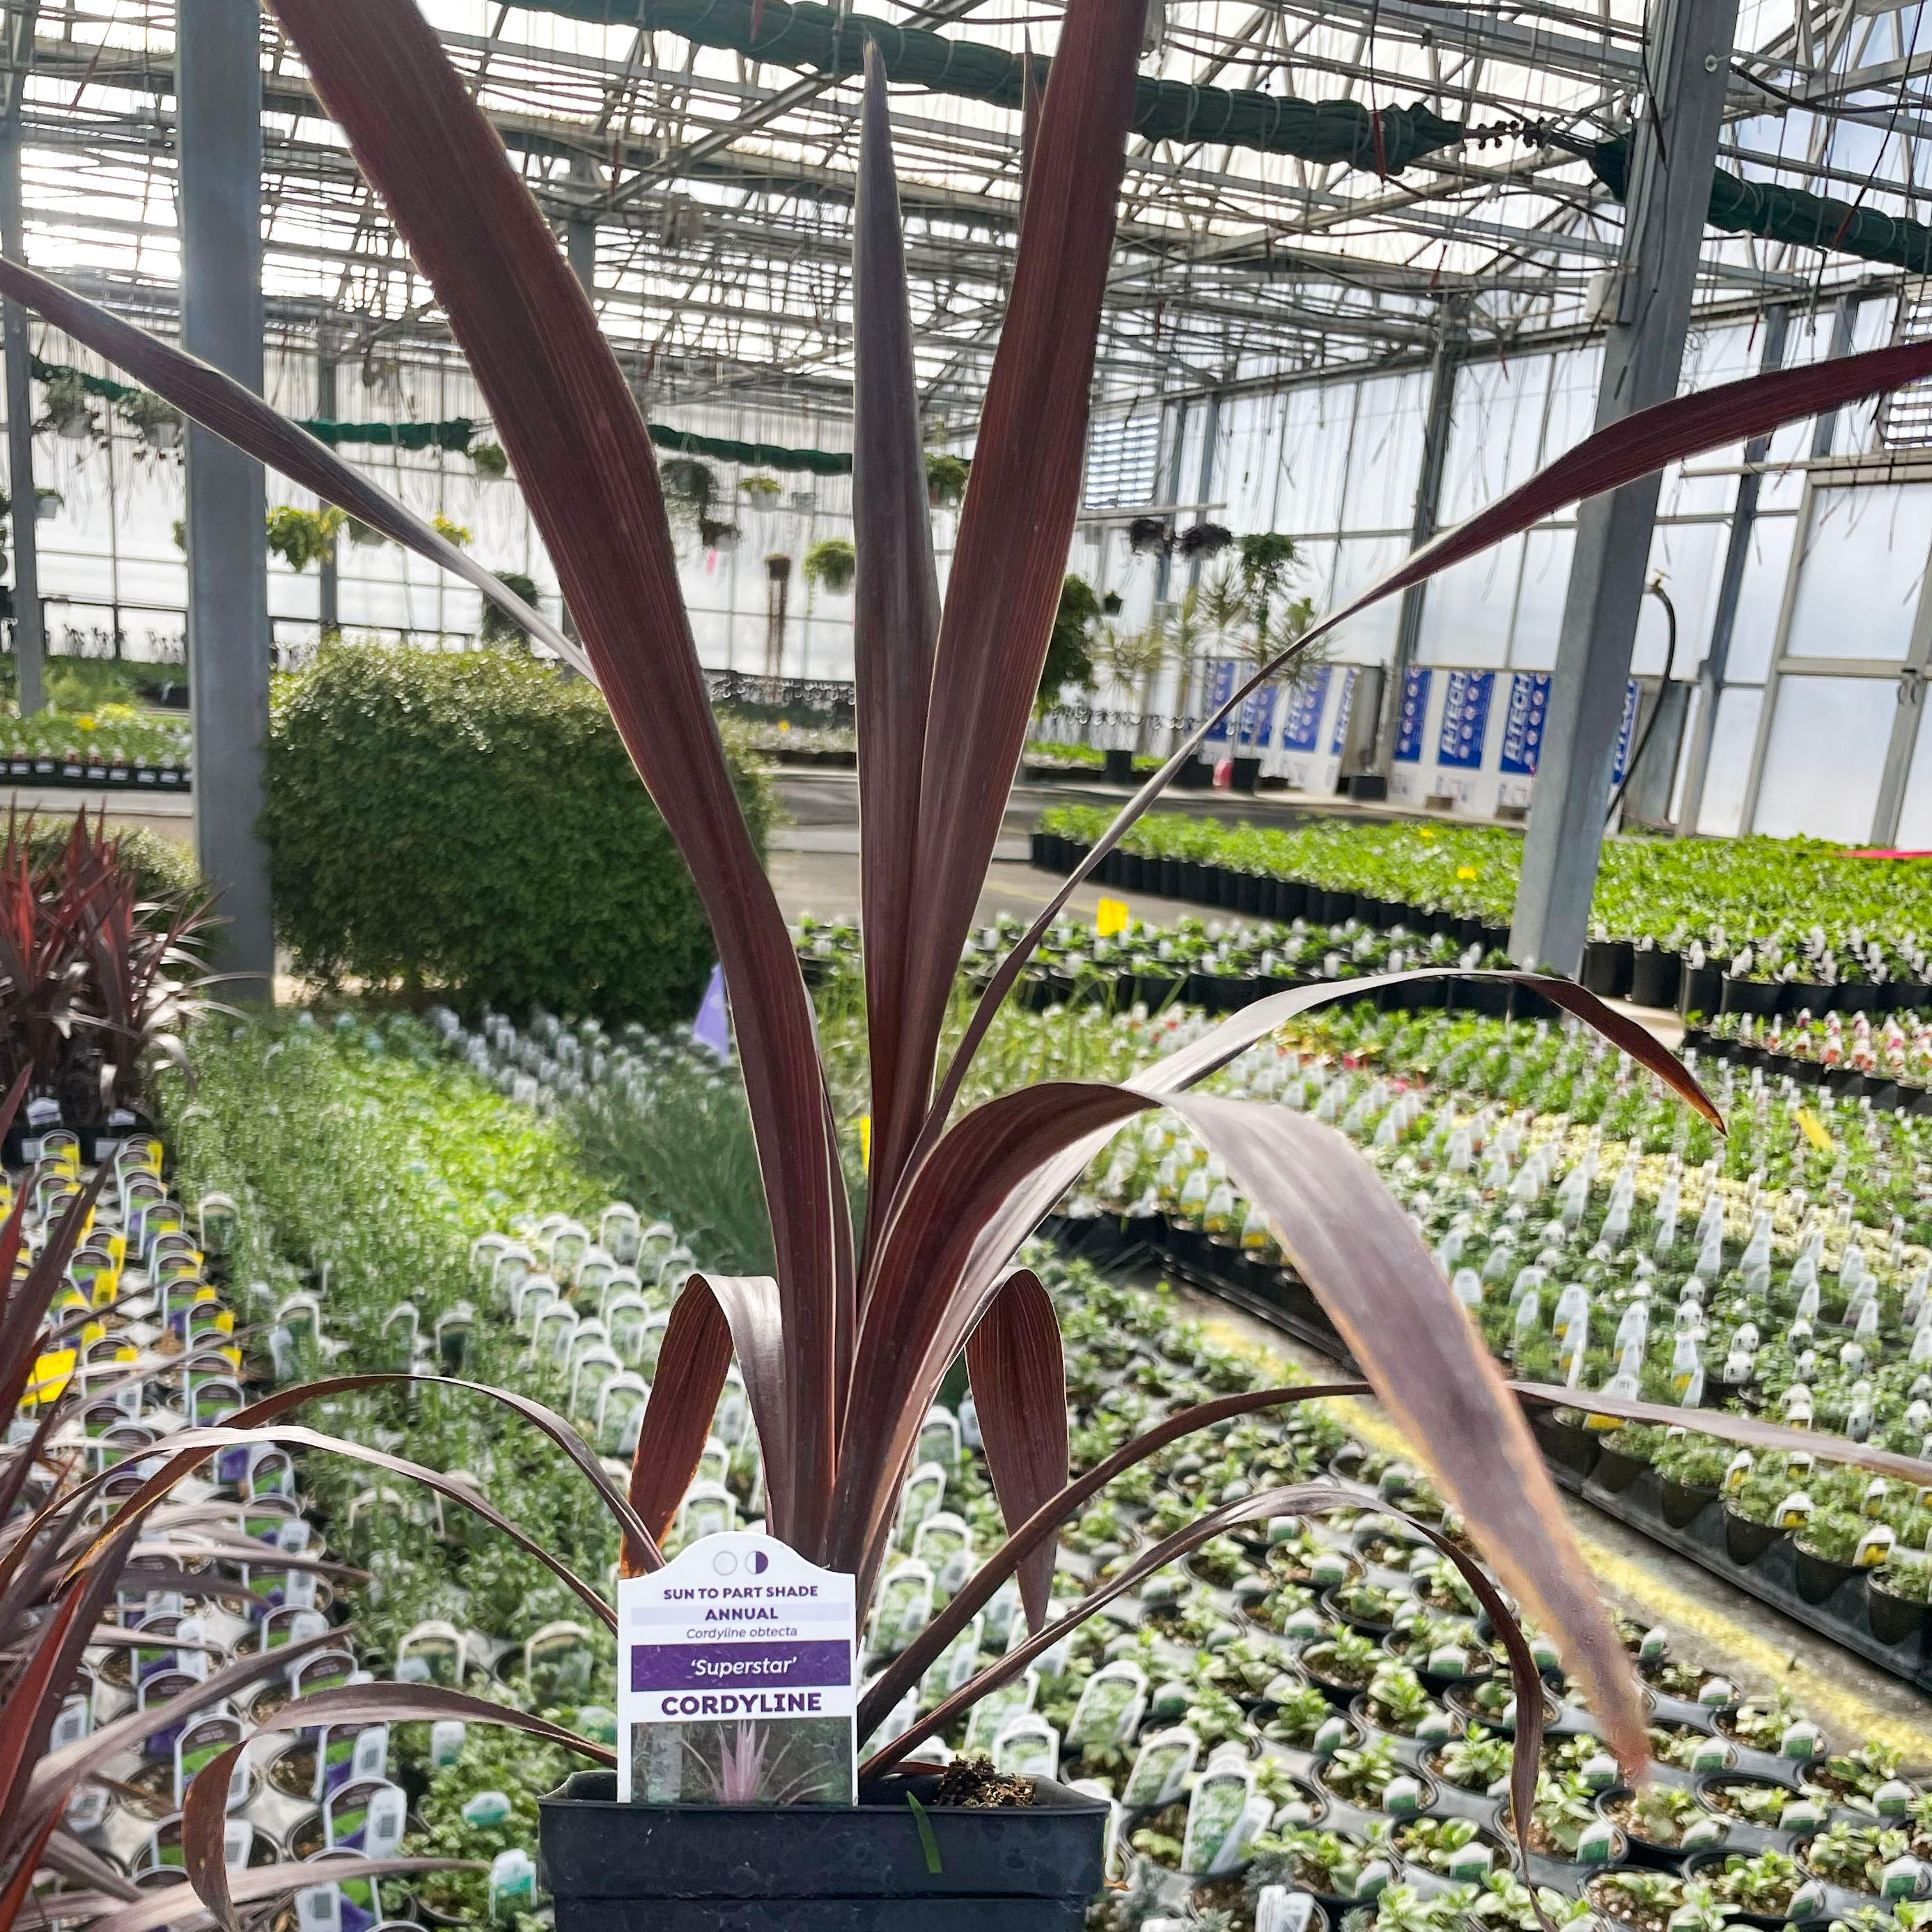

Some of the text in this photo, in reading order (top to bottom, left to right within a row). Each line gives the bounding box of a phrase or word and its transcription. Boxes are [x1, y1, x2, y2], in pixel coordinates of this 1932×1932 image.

[664, 1586, 818, 1600] SUN TO PART SHADE
[705, 1607, 778, 1621] ANNUAL
[687, 1627, 797, 1639] Cordyline obtecta
[662, 1693, 822, 1715] CORDYLINE
